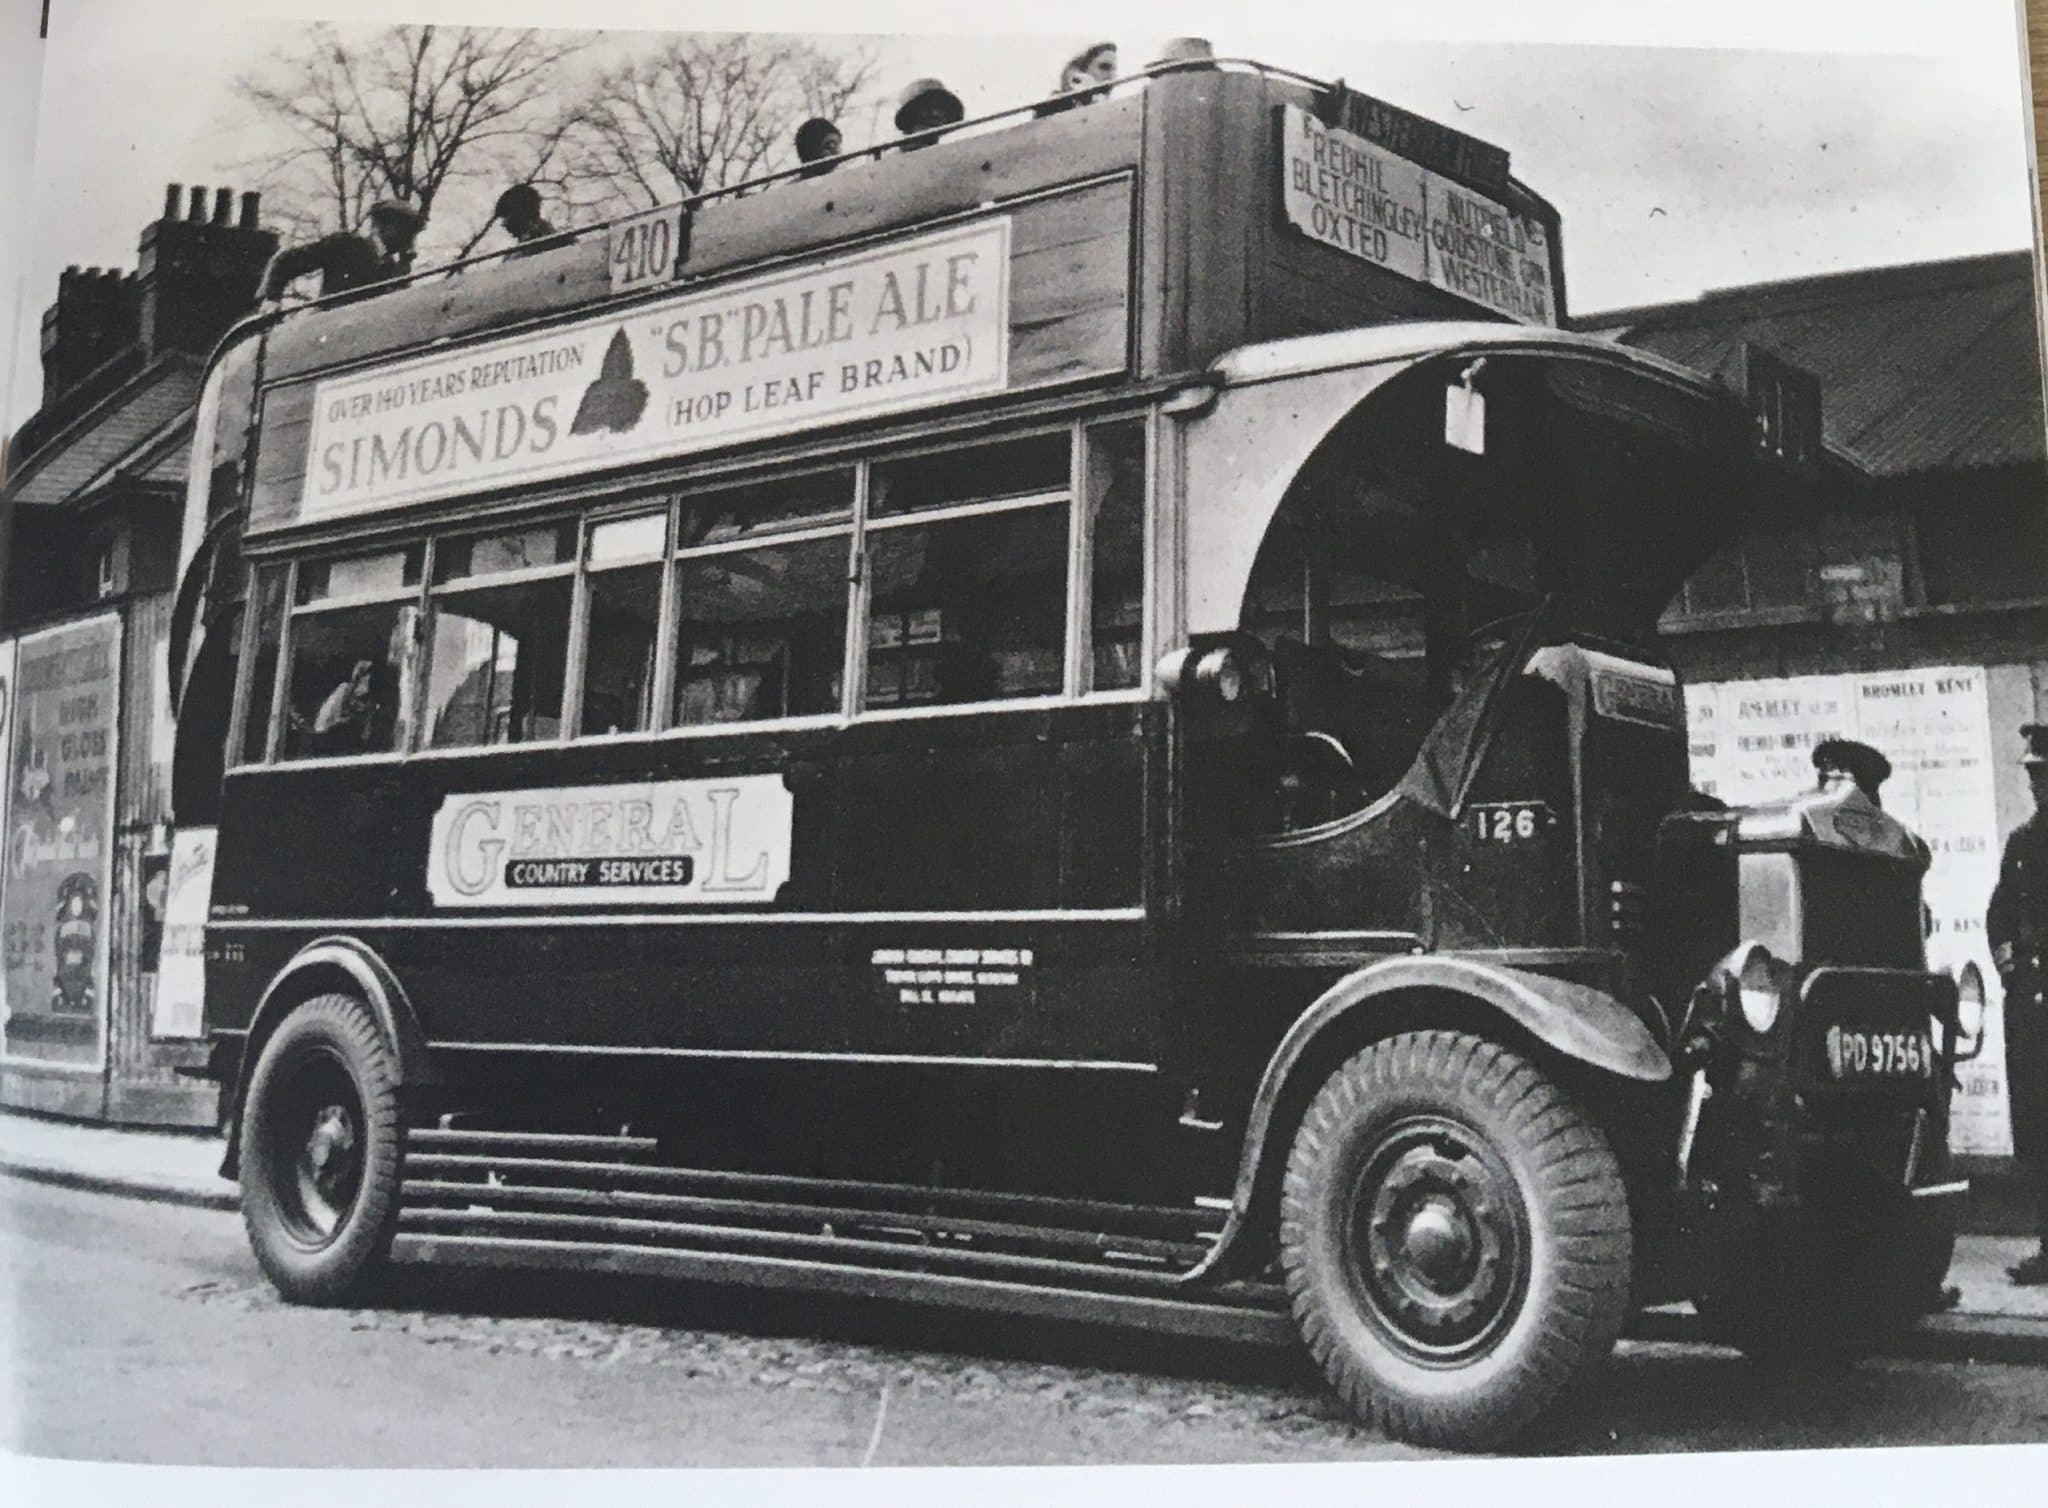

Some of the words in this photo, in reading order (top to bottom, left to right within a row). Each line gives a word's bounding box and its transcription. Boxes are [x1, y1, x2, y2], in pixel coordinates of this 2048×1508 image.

[613, 218, 670, 284] 410
[1311, 202, 1387, 263] OXTED
[740, 280, 854, 364] PALE
[868, 252, 980, 336] ALE
[328, 392, 371, 423] OVER
[408, 369, 467, 409] YEARS
[469, 344, 586, 389] REPUTATION
[744, 371, 825, 413] LEAF
[318, 395, 560, 495] SIMONDS
[445, 787, 769, 897] GENERAL
[1477, 808, 1535, 844] 126
[512, 860, 589, 885] COUNTRY
[599, 859, 685, 883] SERVICES
